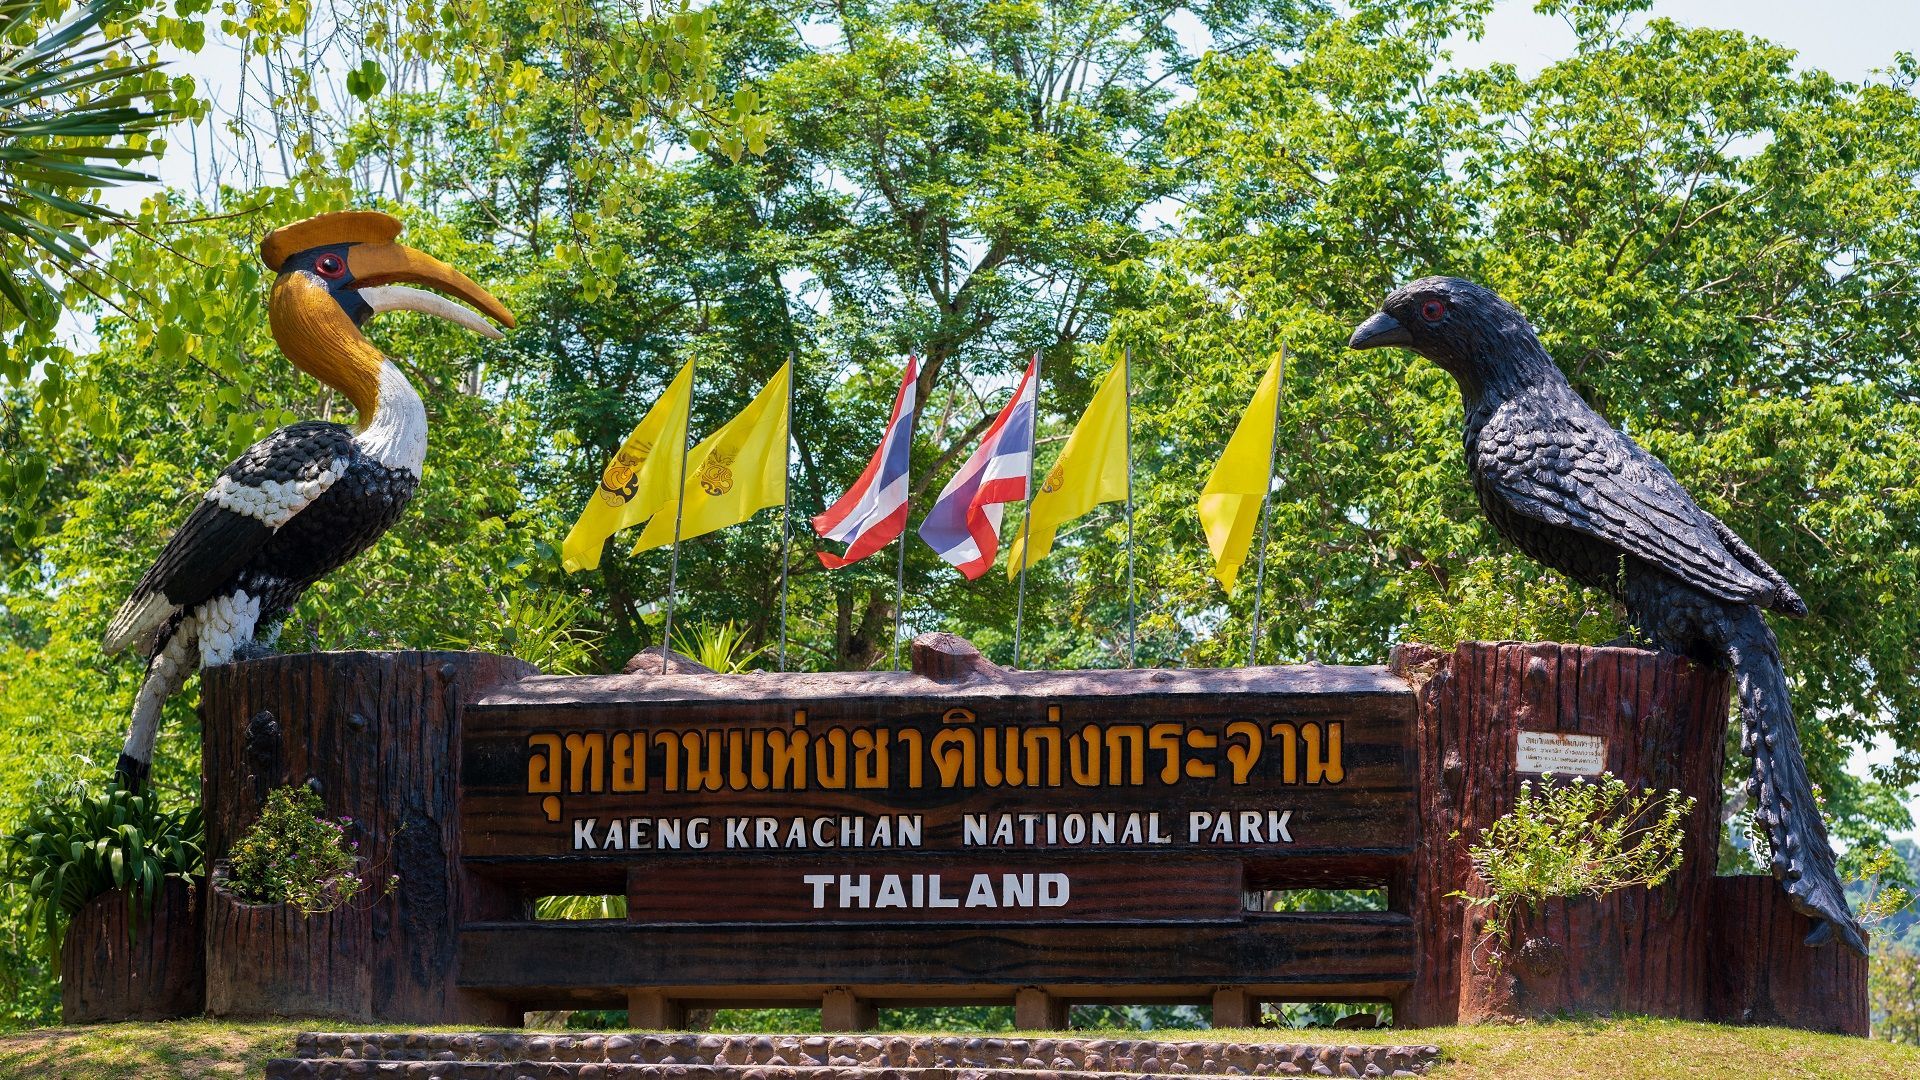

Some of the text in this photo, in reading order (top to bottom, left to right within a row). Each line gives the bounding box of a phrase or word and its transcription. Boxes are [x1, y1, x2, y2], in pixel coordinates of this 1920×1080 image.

[526, 706, 1344, 822] อุทยานแห่งชาติแก่งกระจาน
[573, 811, 1293, 849] KAENG KRACHAN NATIONAL PARK
[803, 872, 1070, 909] THAILAND
